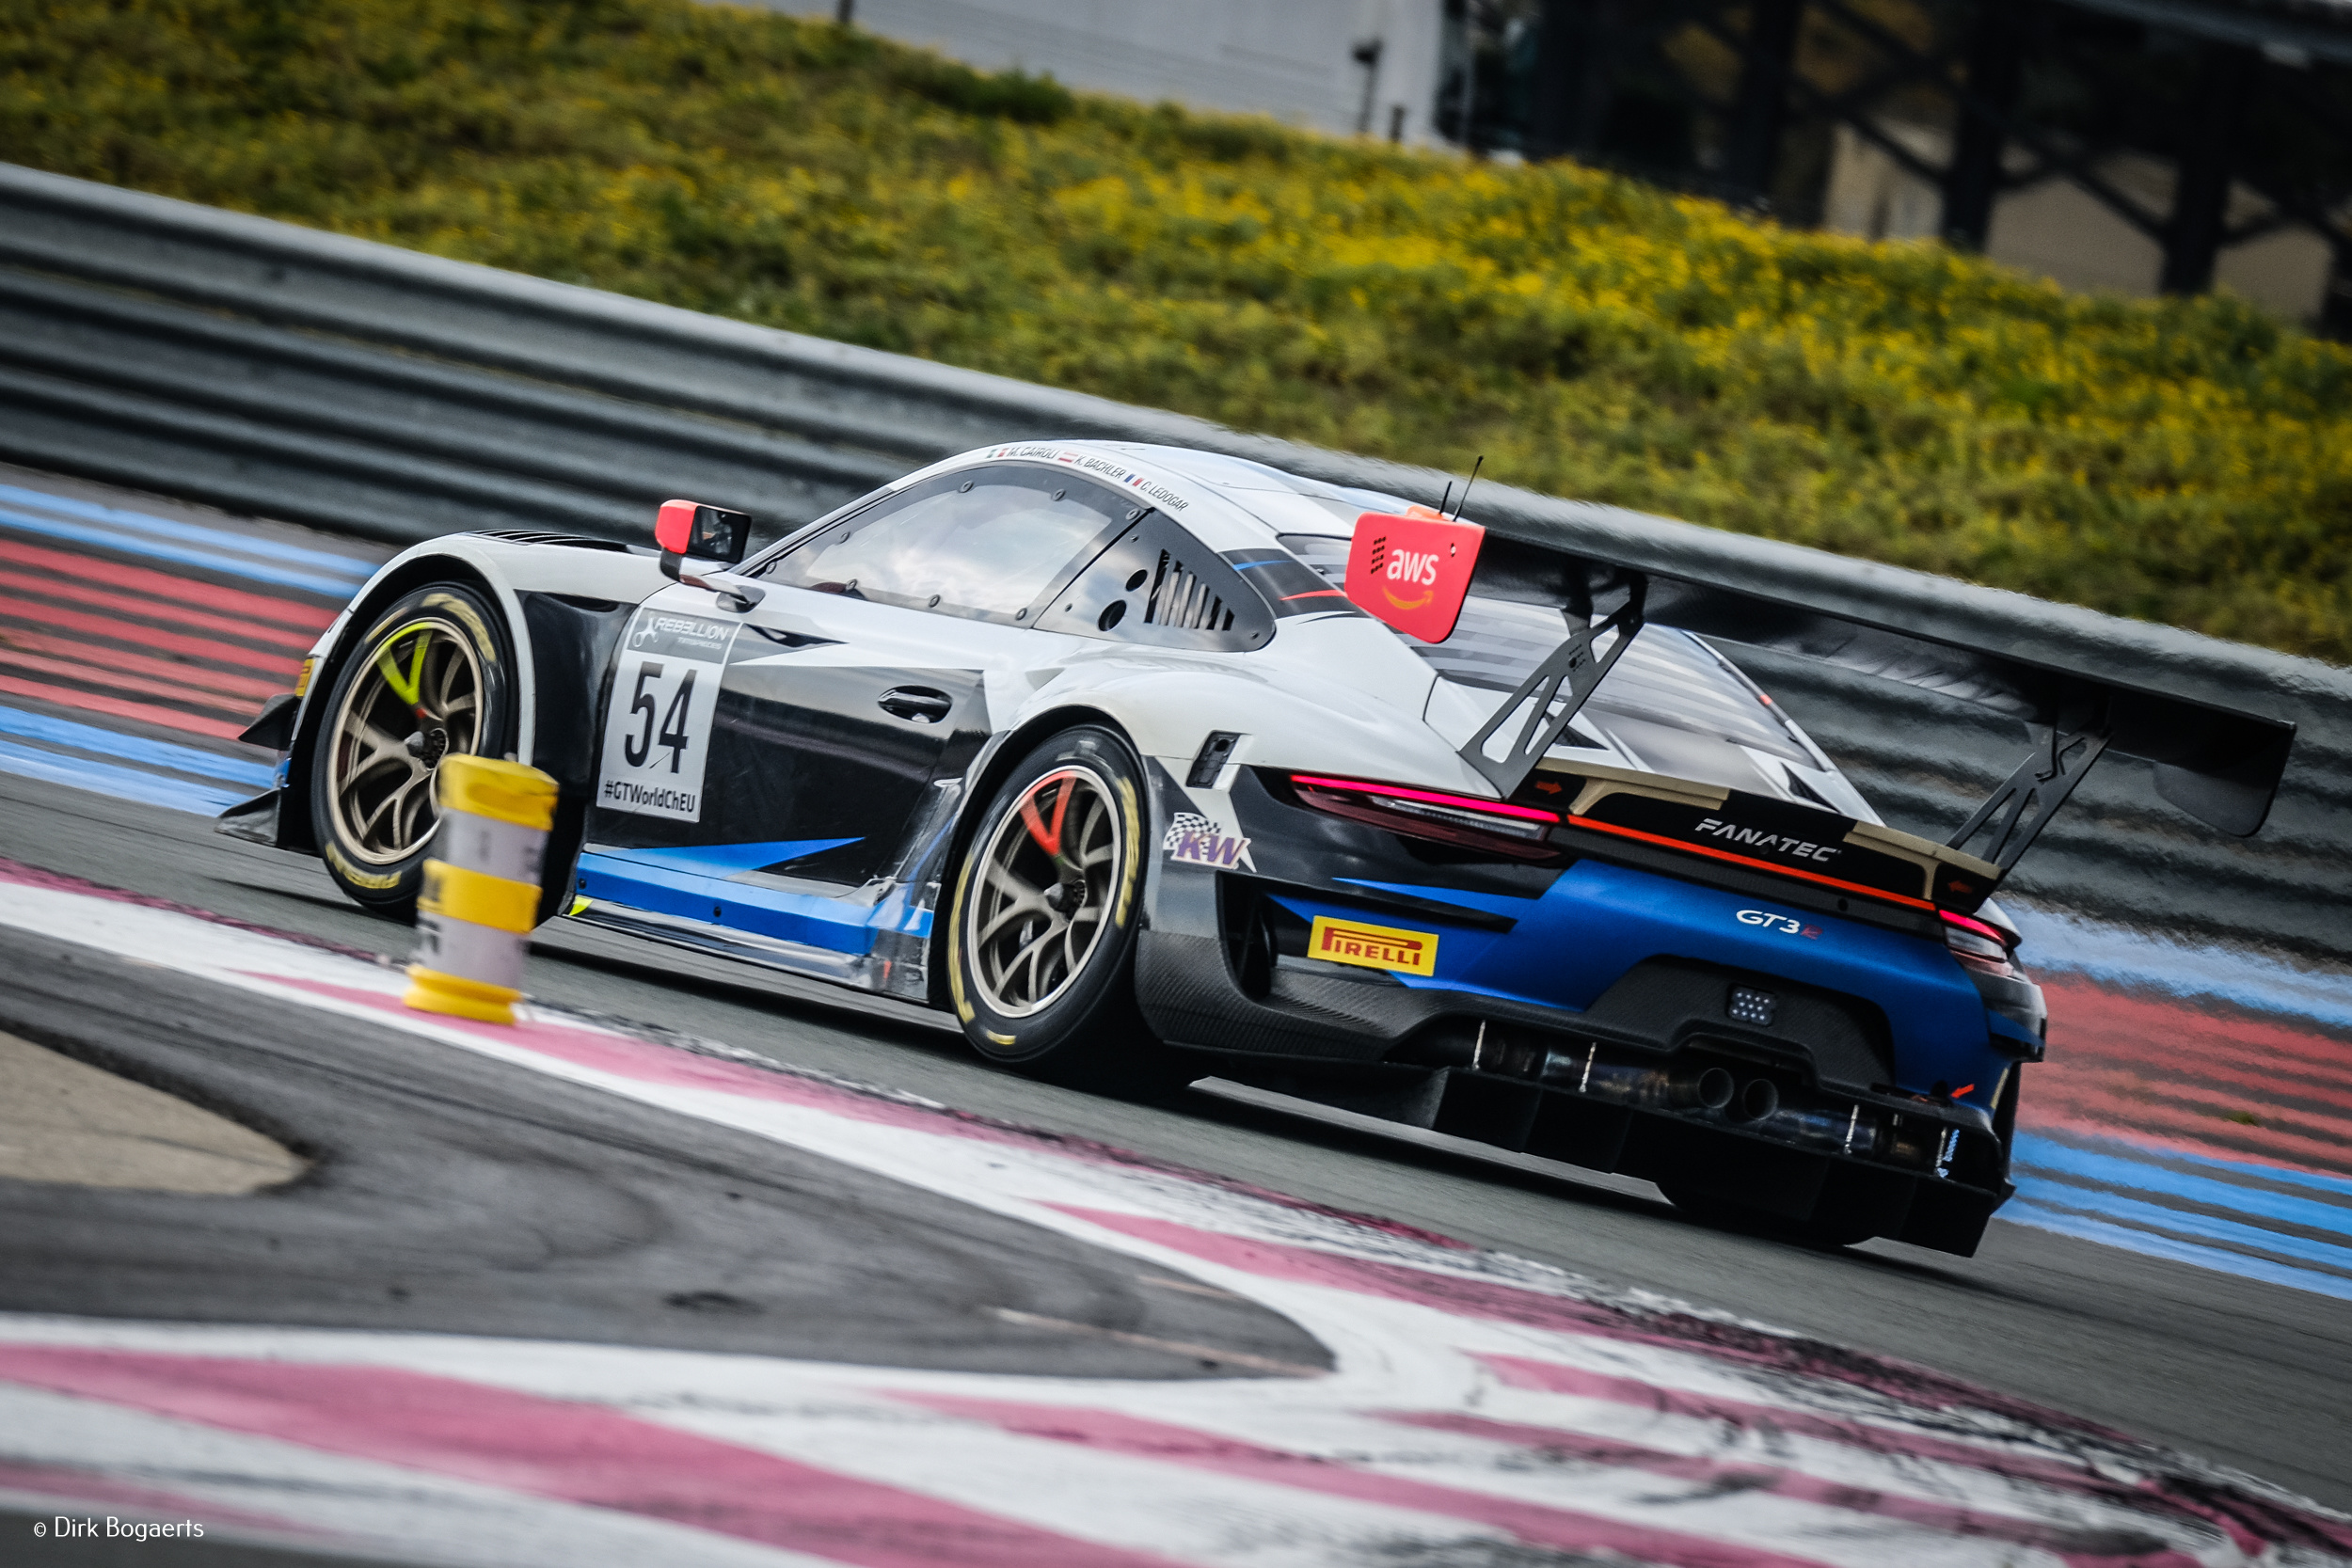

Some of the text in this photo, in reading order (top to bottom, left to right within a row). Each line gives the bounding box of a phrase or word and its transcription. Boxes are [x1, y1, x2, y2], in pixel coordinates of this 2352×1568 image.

[1020, 446, 1061, 460] CAIROLI
[1083, 457, 1127, 480] BACHLER
[1139, 481, 1152, 492] C.
[1148, 484, 1189, 512] LEDOGAR
[1387, 548, 1439, 586] aws
[654, 617, 730, 641] REBELLION
[624, 660, 698, 774] 54
[603, 779, 696, 813] #GTWorldChEU
[1177, 829, 1246, 865] KW
[1694, 817, 1837, 863] FANATEC
[1321, 926, 1423, 966] PIRELLI
